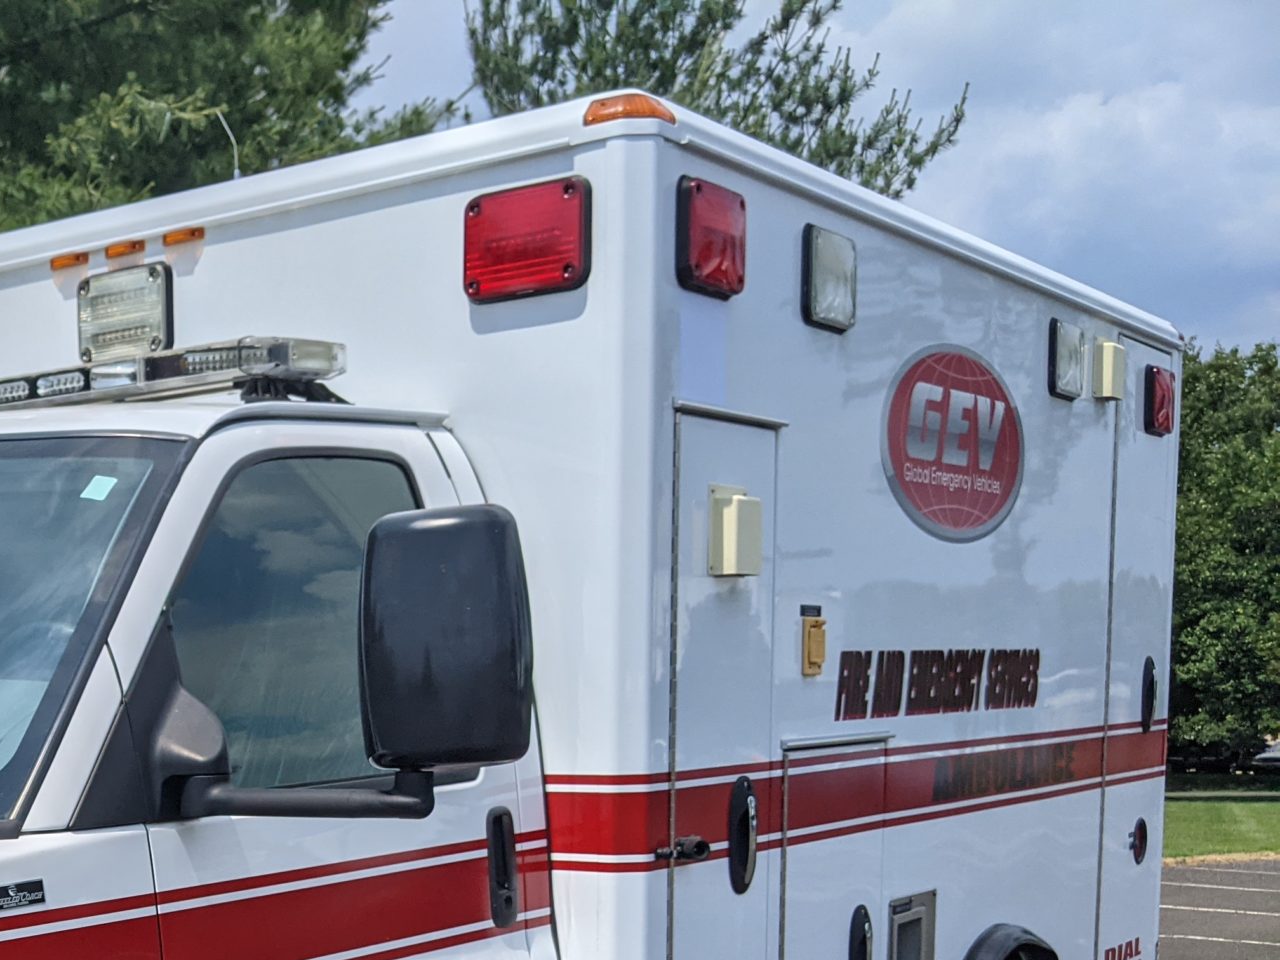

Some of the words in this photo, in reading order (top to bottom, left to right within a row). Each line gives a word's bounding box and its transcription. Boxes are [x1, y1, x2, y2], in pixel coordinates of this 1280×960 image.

[906, 381, 1006, 472] GEV
[904, 463, 931, 484] Global
[931, 467, 972, 493] Emergency
[973, 473, 1000, 495] Vehicles
[932, 739, 1076, 802] AMBULANCE
